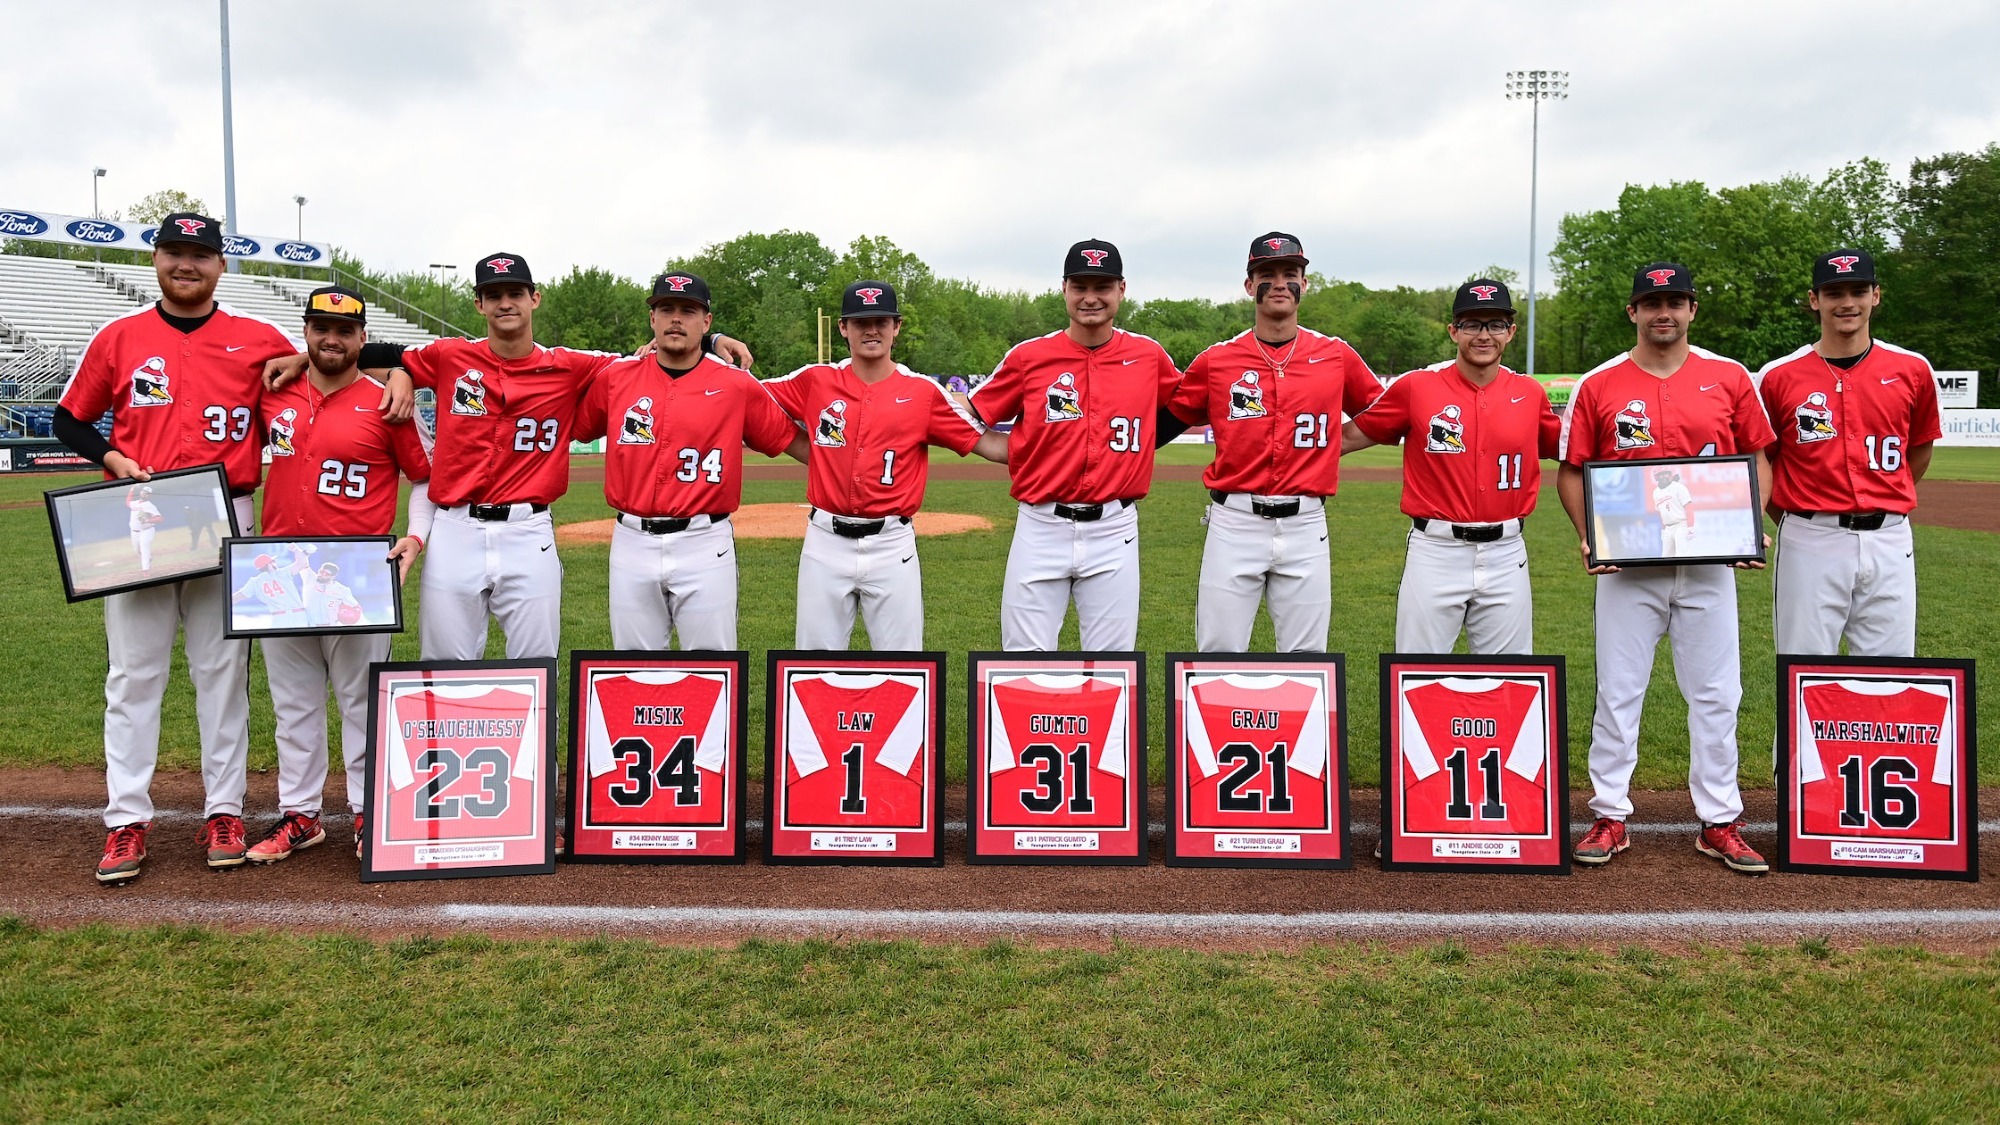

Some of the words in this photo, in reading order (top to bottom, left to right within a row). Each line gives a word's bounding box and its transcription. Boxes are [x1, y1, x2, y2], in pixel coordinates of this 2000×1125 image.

[0, 213, 38, 234] Ford
[76, 221, 116, 242] Ford
[174, 218, 206, 236] Y
[282, 243, 314, 261] Ford
[1080, 248, 1109, 267] Y
[486, 258, 514, 274] Y
[1828, 255, 1860, 273] Y
[664, 276, 693, 292] Y
[1645, 268, 1676, 286] Y
[856, 288, 883, 304] Y
[1469, 285, 1498, 300] Y
[203, 406, 251, 442] 33
[514, 417, 560, 452] 23
[1108, 416, 1142, 453] 31
[1293, 412, 1330, 449] 21
[1865, 435, 1902, 472] 16
[676, 448, 722, 484] 34
[880, 450, 896, 486] 1
[1498, 453, 1522, 490] 11
[317, 458, 369, 499] 25
[262, 580, 285, 598] 44
[634, 705, 685, 726] MISIK
[837, 712, 875, 732] LAW
[1030, 714, 1088, 735] GUMTO
[1231, 710, 1279, 730] GRAU
[403, 718, 524, 740] O'SHAUGHNESSY
[1450, 717, 1496, 739] GOOD
[1813, 720, 1939, 745] MARSHALWITZ
[608, 735, 702, 808] 34
[839, 742, 867, 814] 1
[1019, 743, 1096, 814] 31
[1216, 742, 1294, 813] 21
[414, 748, 510, 820] 23
[1446, 747, 1507, 821] 11
[1838, 755, 1919, 830] 16
